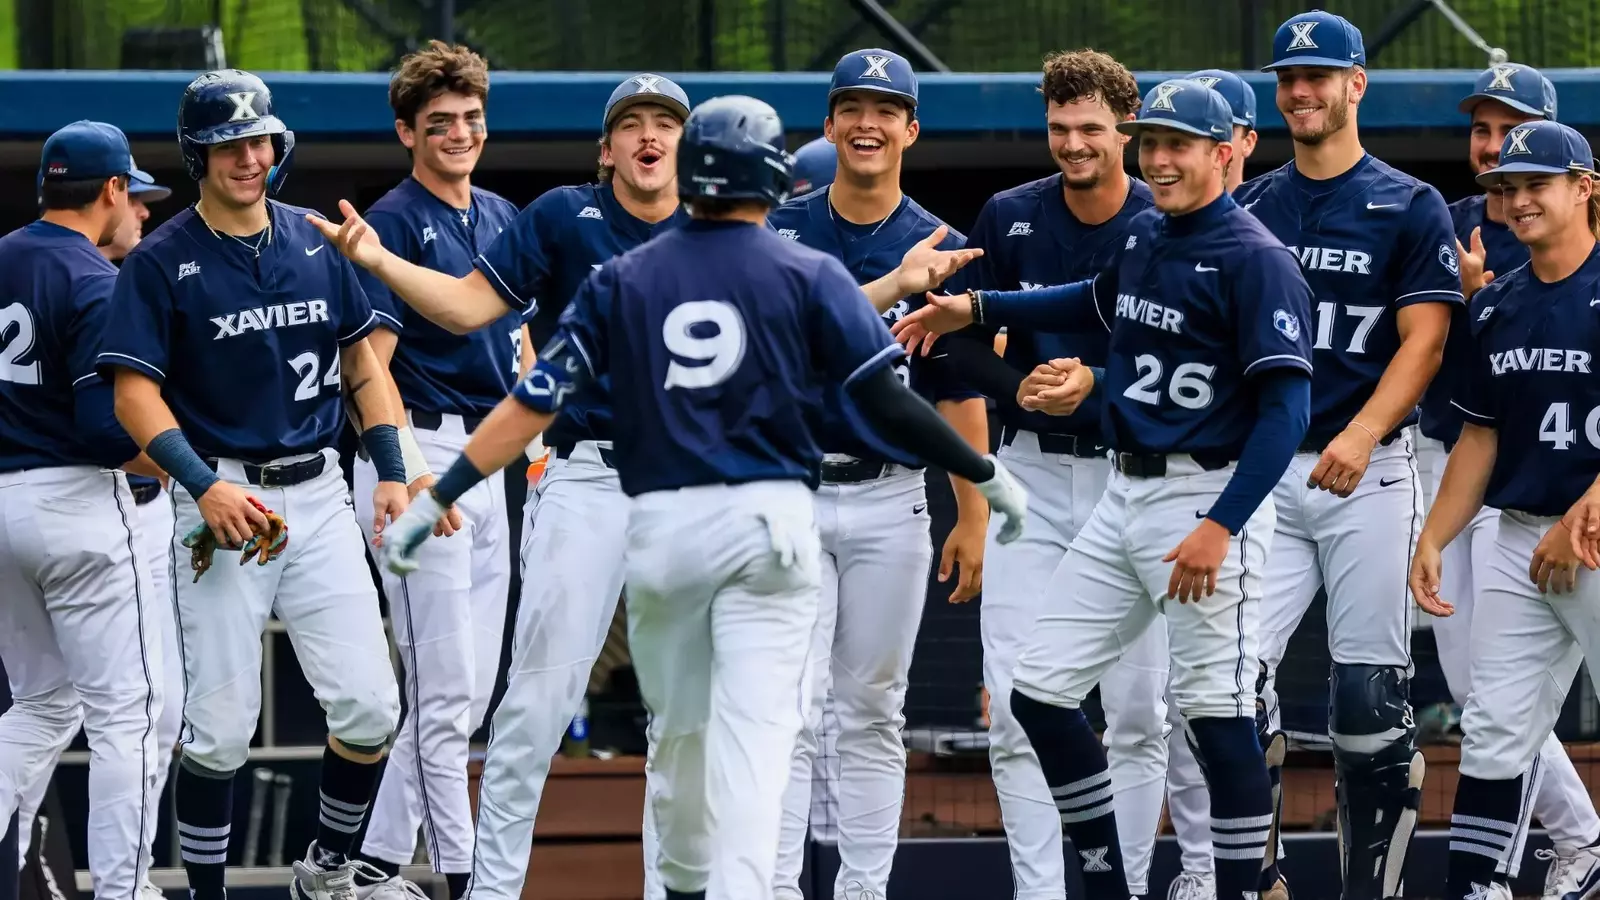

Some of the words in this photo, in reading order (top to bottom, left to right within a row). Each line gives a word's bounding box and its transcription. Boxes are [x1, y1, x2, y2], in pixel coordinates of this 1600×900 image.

[1285, 22, 1319, 52] X
[857, 55, 893, 82] X
[1484, 67, 1520, 92] X
[631, 75, 664, 96] X
[1145, 85, 1180, 113] X
[224, 91, 262, 124] X
[1503, 129, 1537, 158] X
[1008, 228, 1034, 236] EAST
[1012, 222, 1031, 230] BIG
[1286, 246, 1373, 275] VIER
[209, 298, 330, 341] XAVIER
[1312, 300, 1386, 354] 17
[663, 300, 749, 392] 9
[1489, 348, 1593, 375] XAVIER
[1122, 354, 1216, 410] 26
[1078, 845, 1113, 873] X
